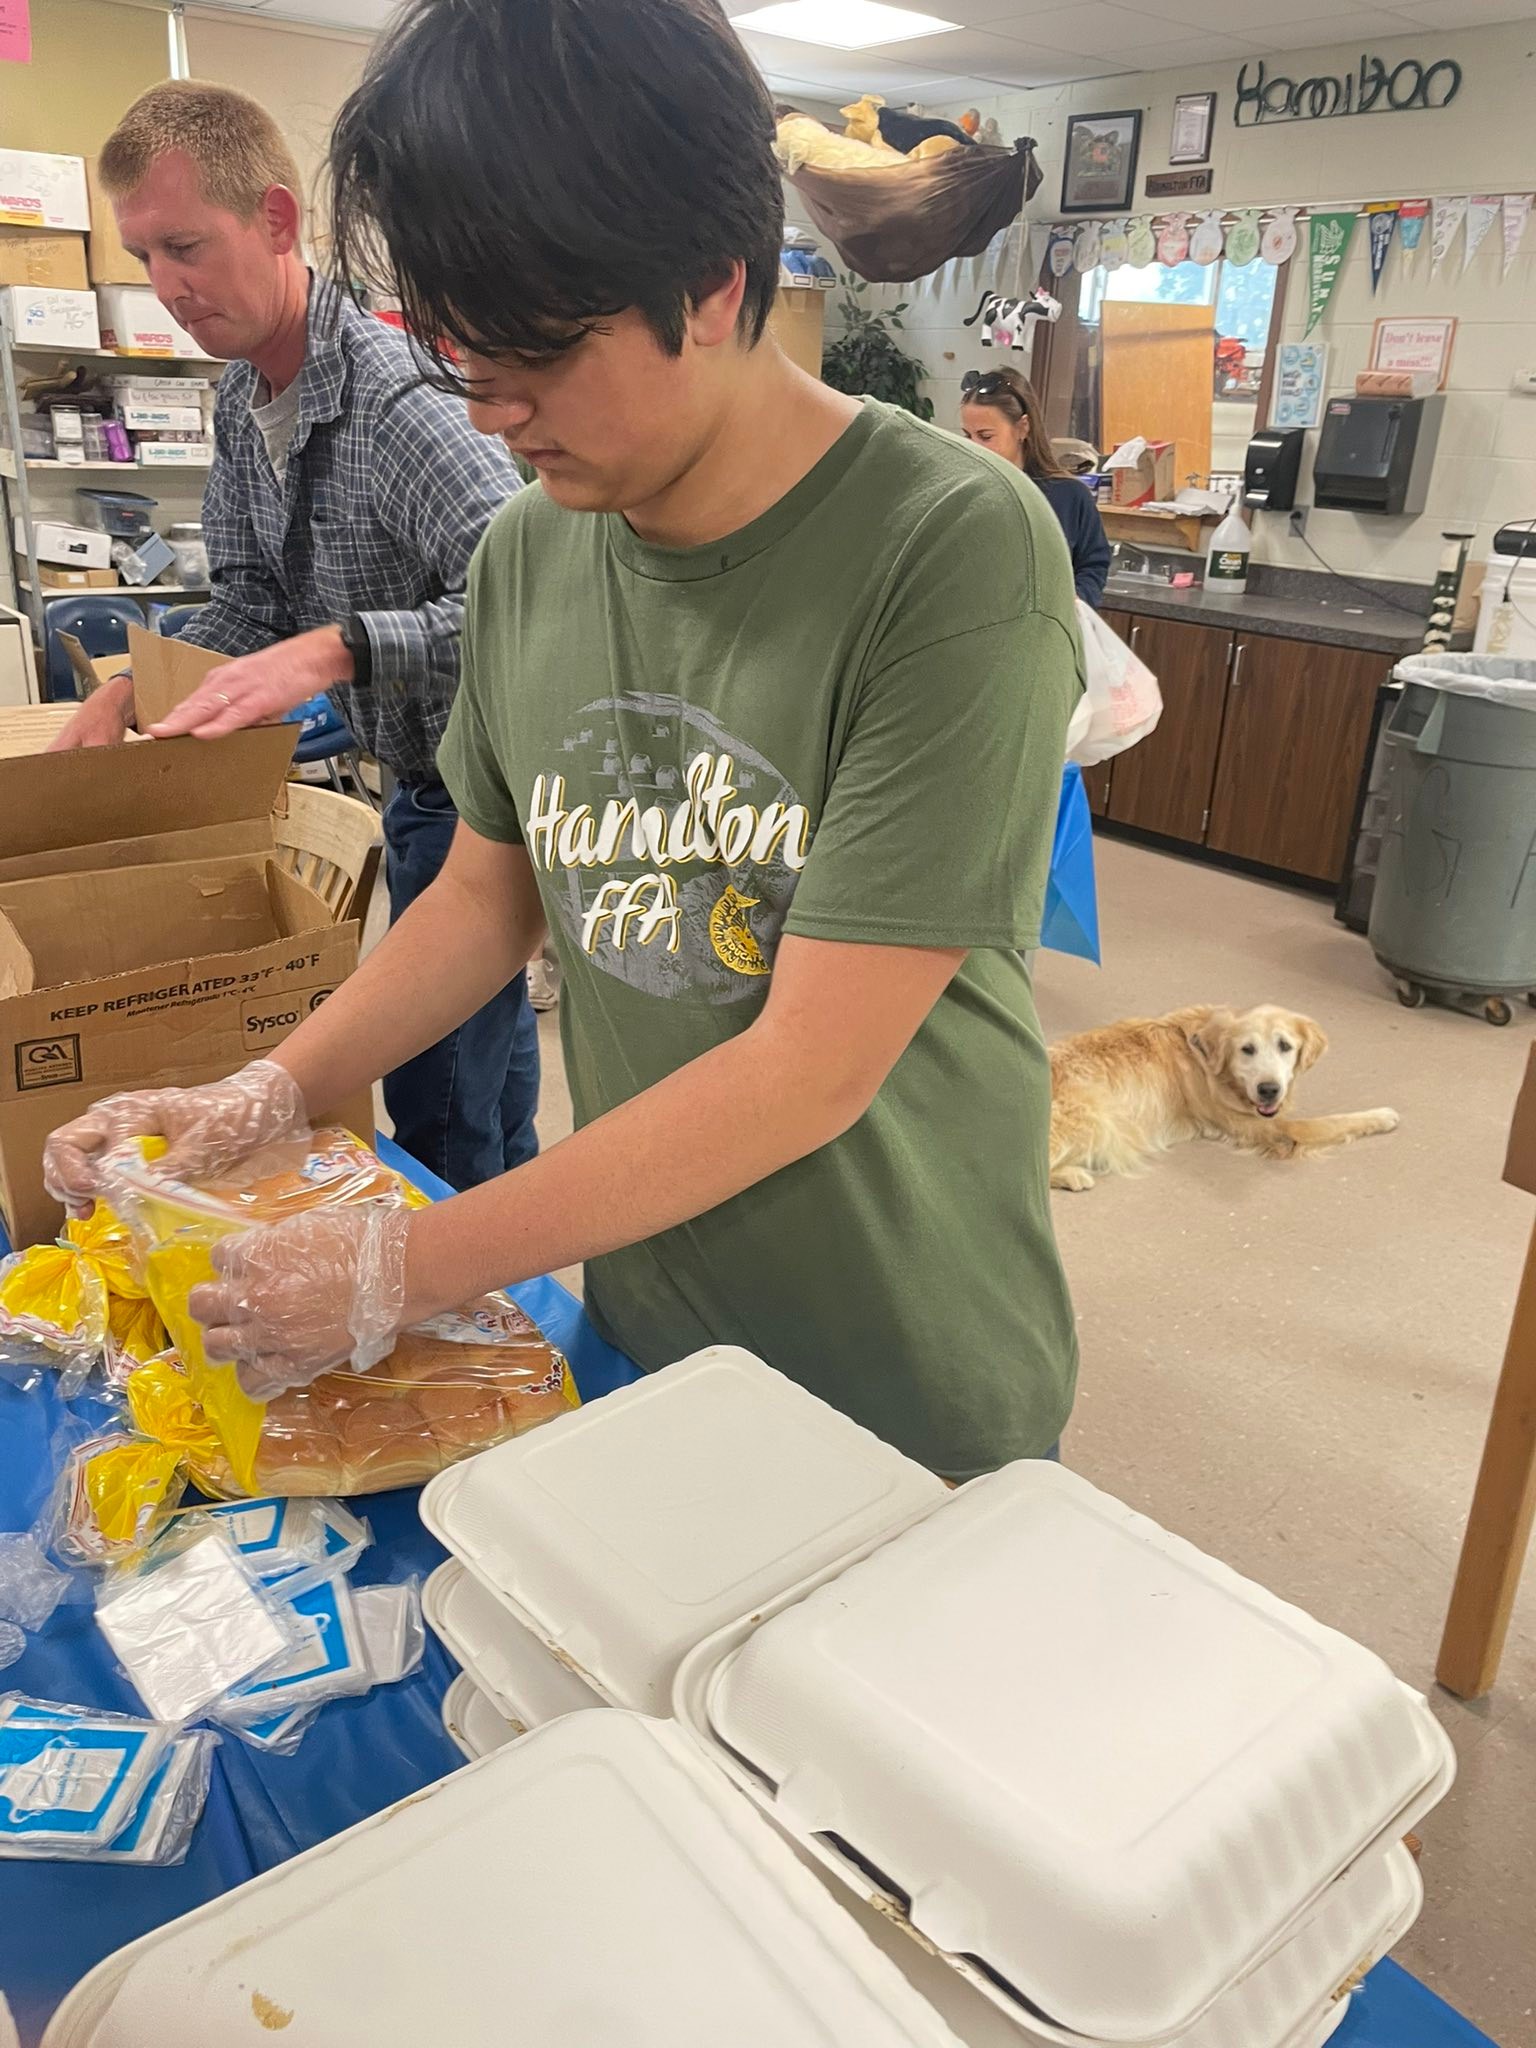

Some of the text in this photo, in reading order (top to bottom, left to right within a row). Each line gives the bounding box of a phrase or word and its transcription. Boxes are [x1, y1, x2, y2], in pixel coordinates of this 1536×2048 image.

[582, 872, 683, 955] FFA
[50, 1004, 98, 1022] KEEP
[103, 976, 236, 1013] REFRIGERATED
[246, 1011, 298, 1034] Sysco
